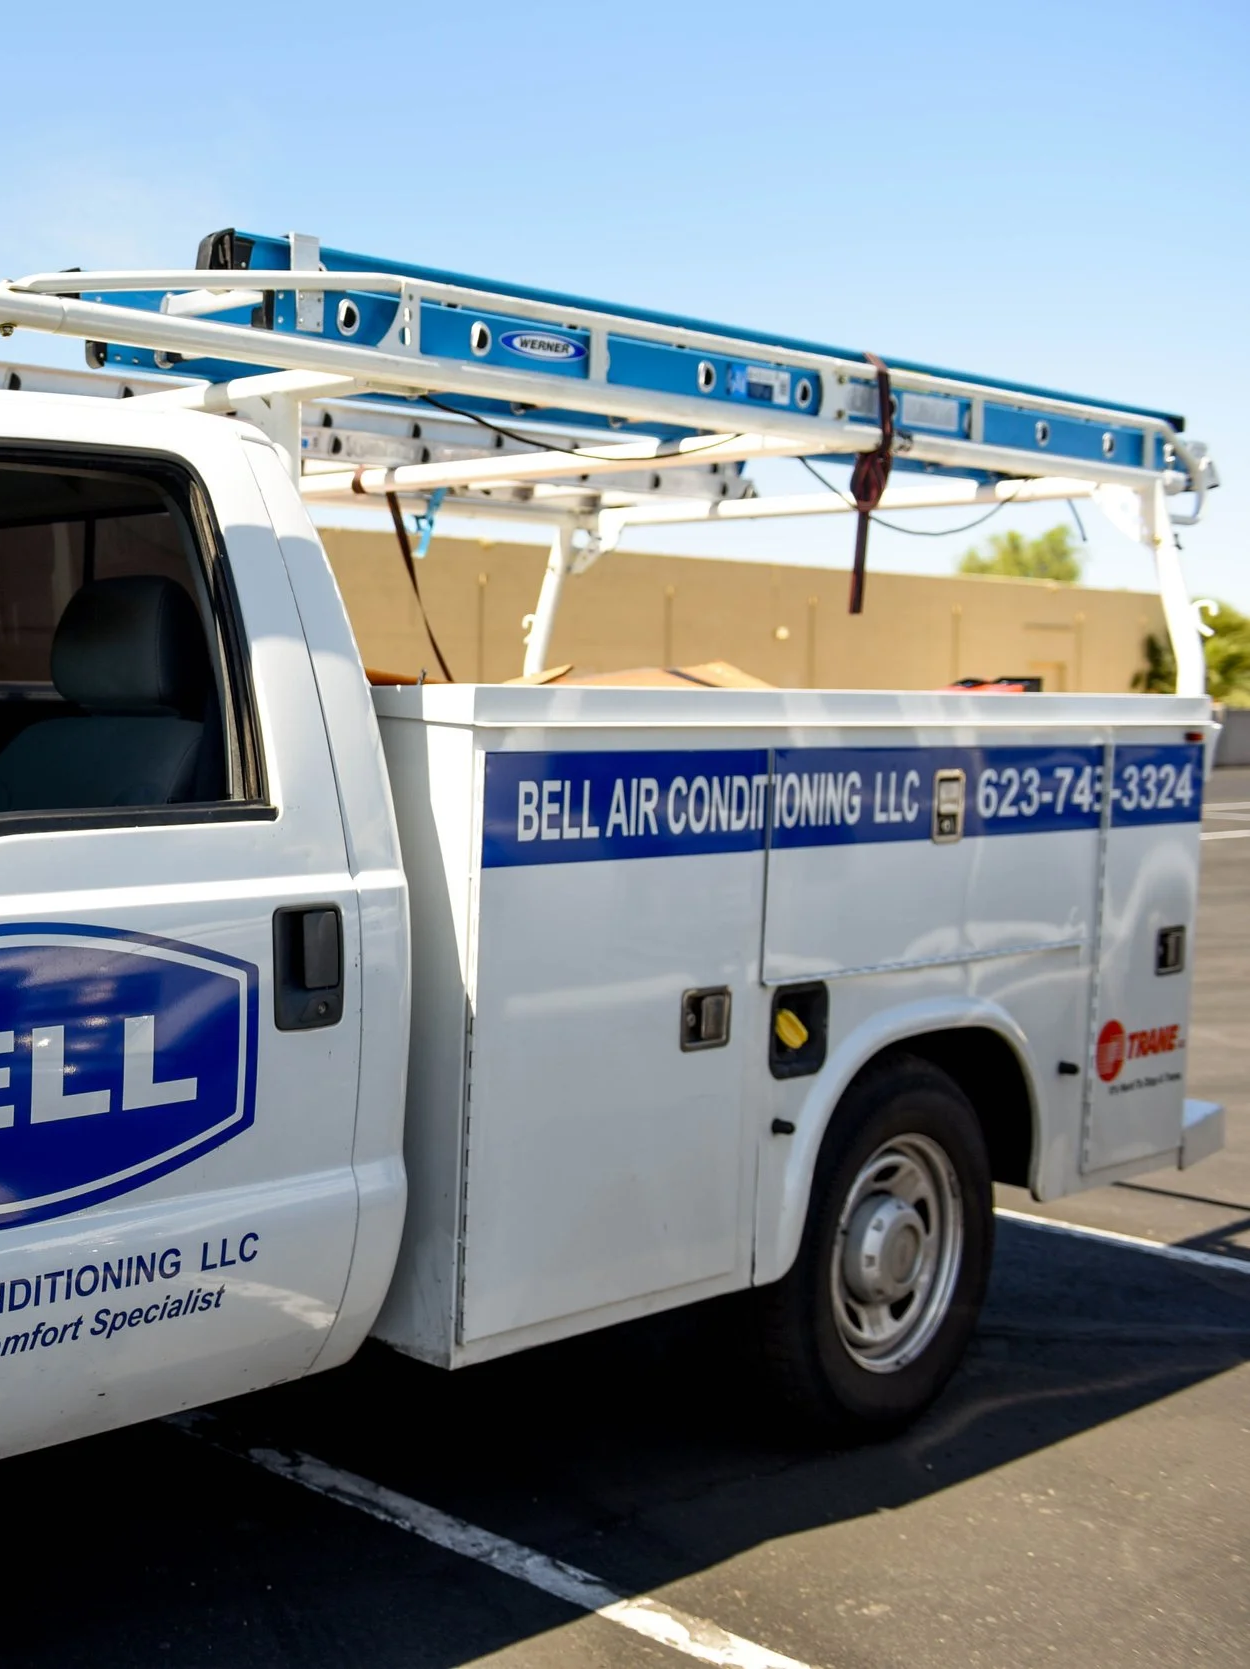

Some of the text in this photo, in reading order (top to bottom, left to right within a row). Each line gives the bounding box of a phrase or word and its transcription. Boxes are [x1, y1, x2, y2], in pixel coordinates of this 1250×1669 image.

[519, 336, 570, 353] WERNER
[518, 768, 921, 842] BELL AIR CONDITIONING LLC
[1128, 1024, 1178, 1059] TRANE
[200, 1232, 260, 1272] LLC
[90, 1284, 226, 1339] Specialist
